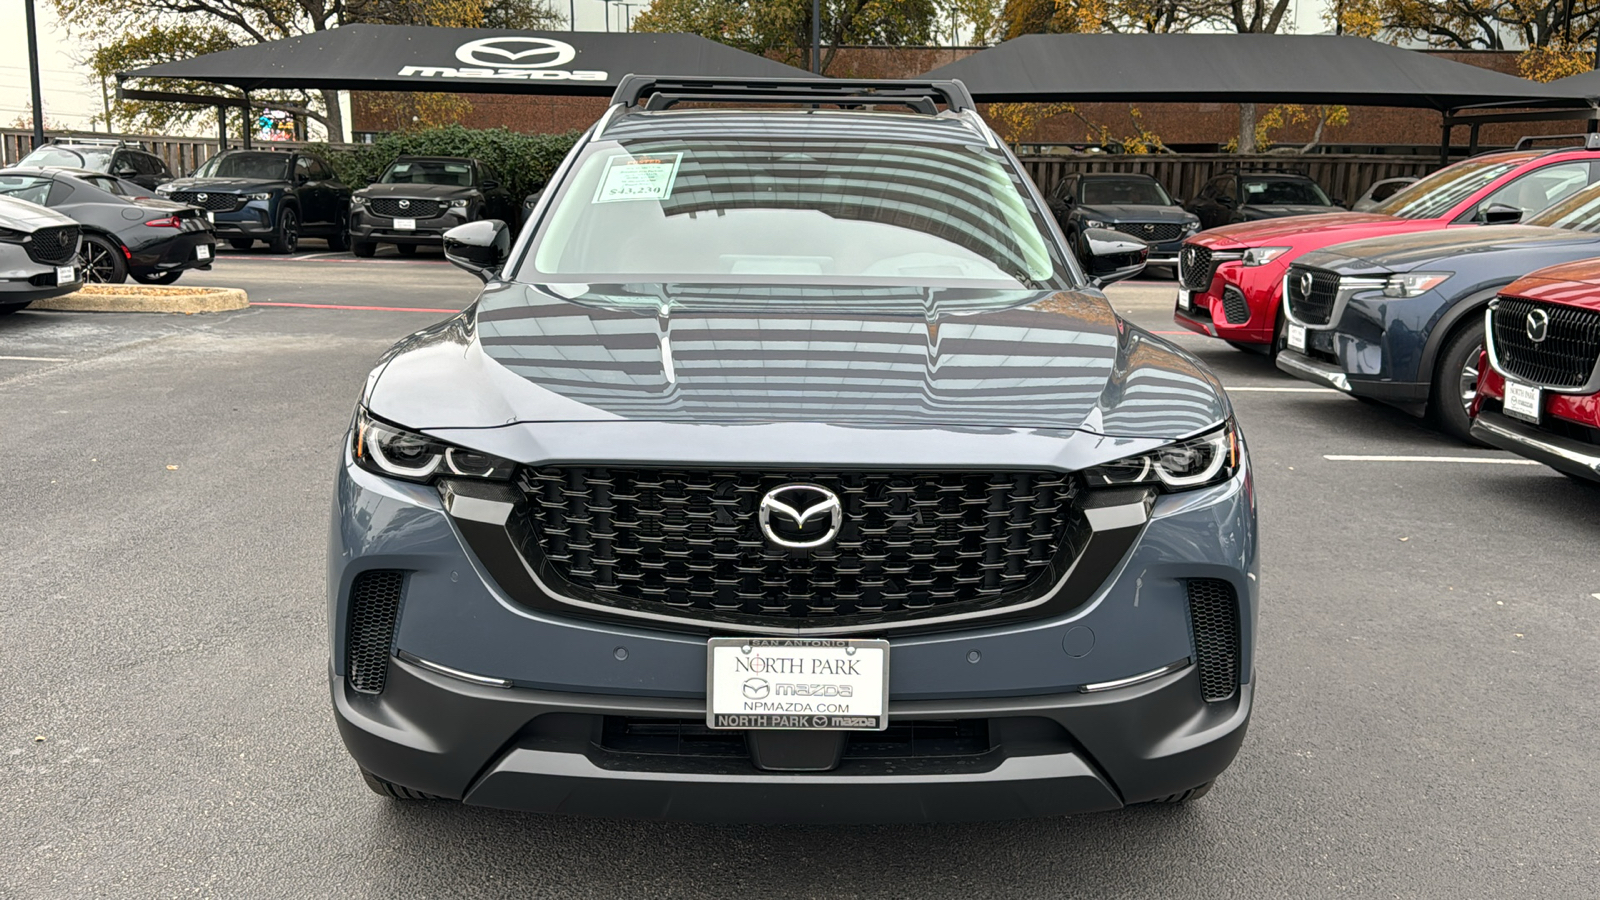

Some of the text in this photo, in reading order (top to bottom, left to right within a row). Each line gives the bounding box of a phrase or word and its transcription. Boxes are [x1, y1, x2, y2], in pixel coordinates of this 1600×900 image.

[609, 186, 661, 195] $43,230
[735, 655, 861, 676] NORTH PARK
[744, 701, 850, 713] NPMAZDA.COM
[718, 715, 767, 727] NORTH
[771, 715, 809, 727] PARK
